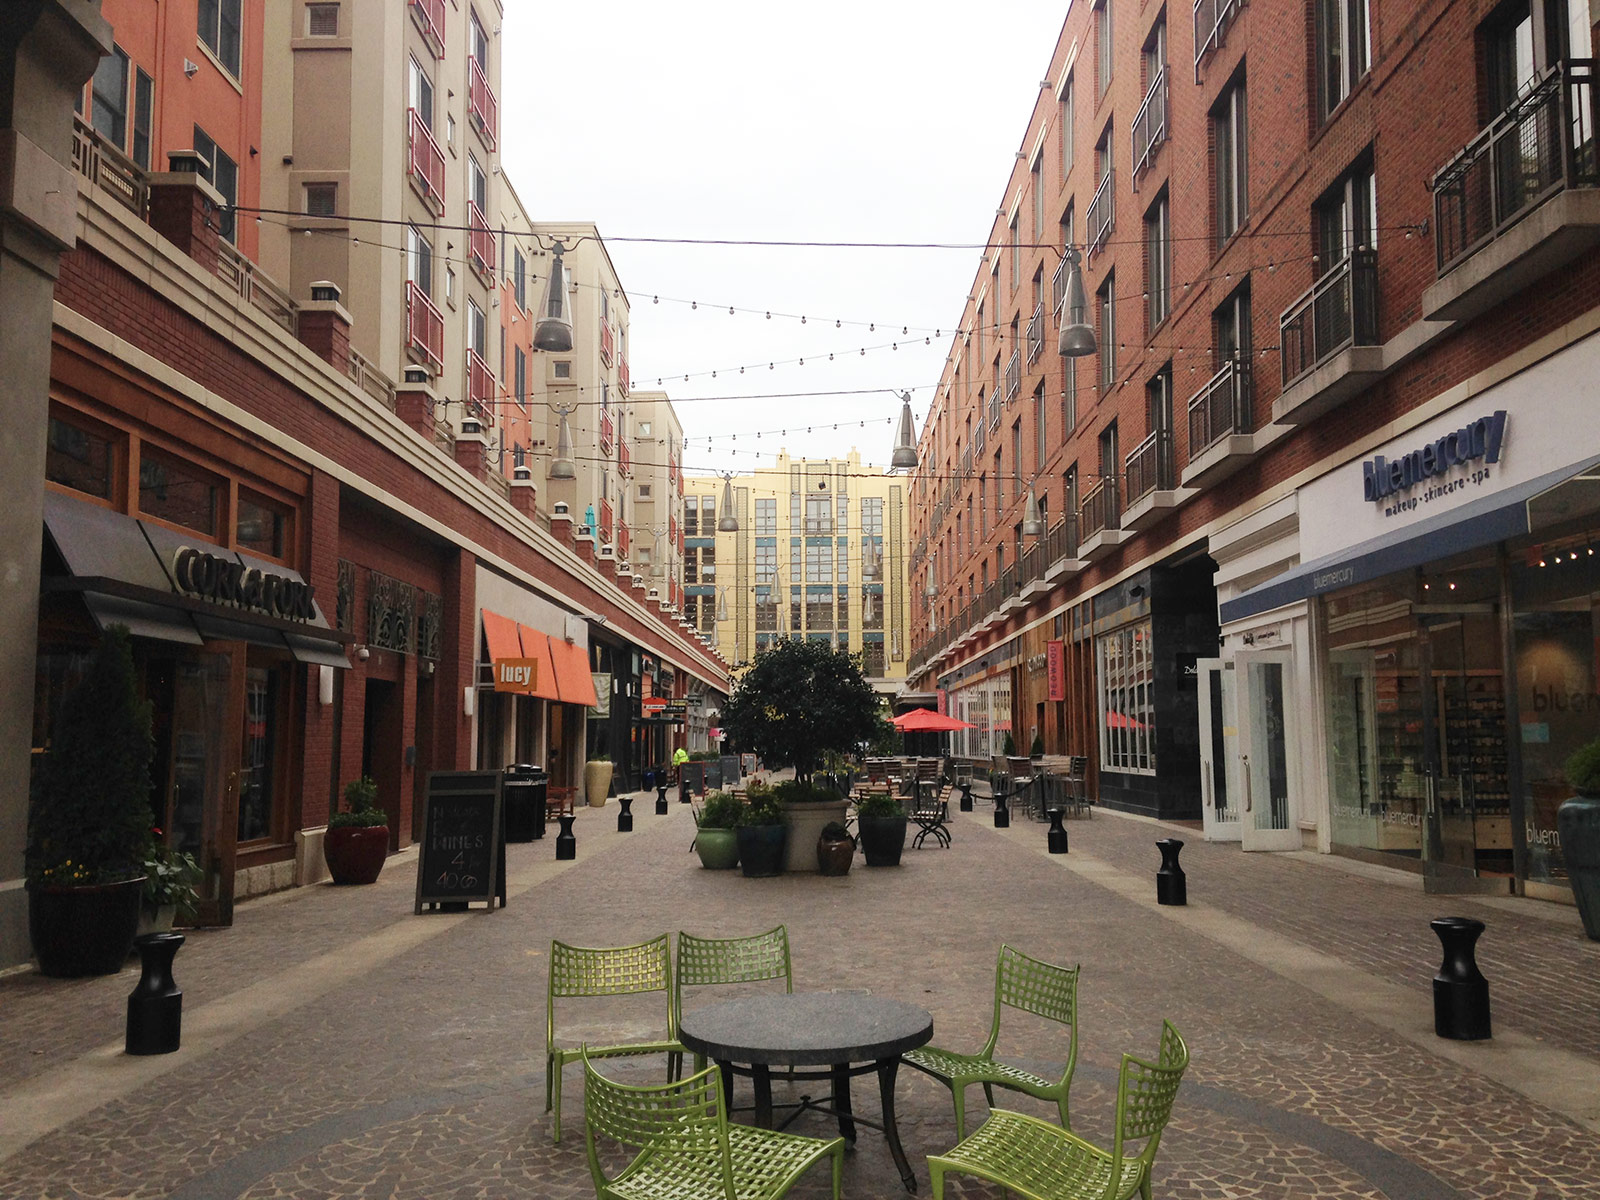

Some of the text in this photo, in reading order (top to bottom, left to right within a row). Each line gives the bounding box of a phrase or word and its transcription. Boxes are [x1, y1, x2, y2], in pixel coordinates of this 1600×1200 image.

[1363, 410, 1508, 502] bluemercury
[1385, 467, 1490, 518] makeup skincare spa
[1313, 566, 1354, 590] bluemercury
[500, 663, 531, 686] lucy
